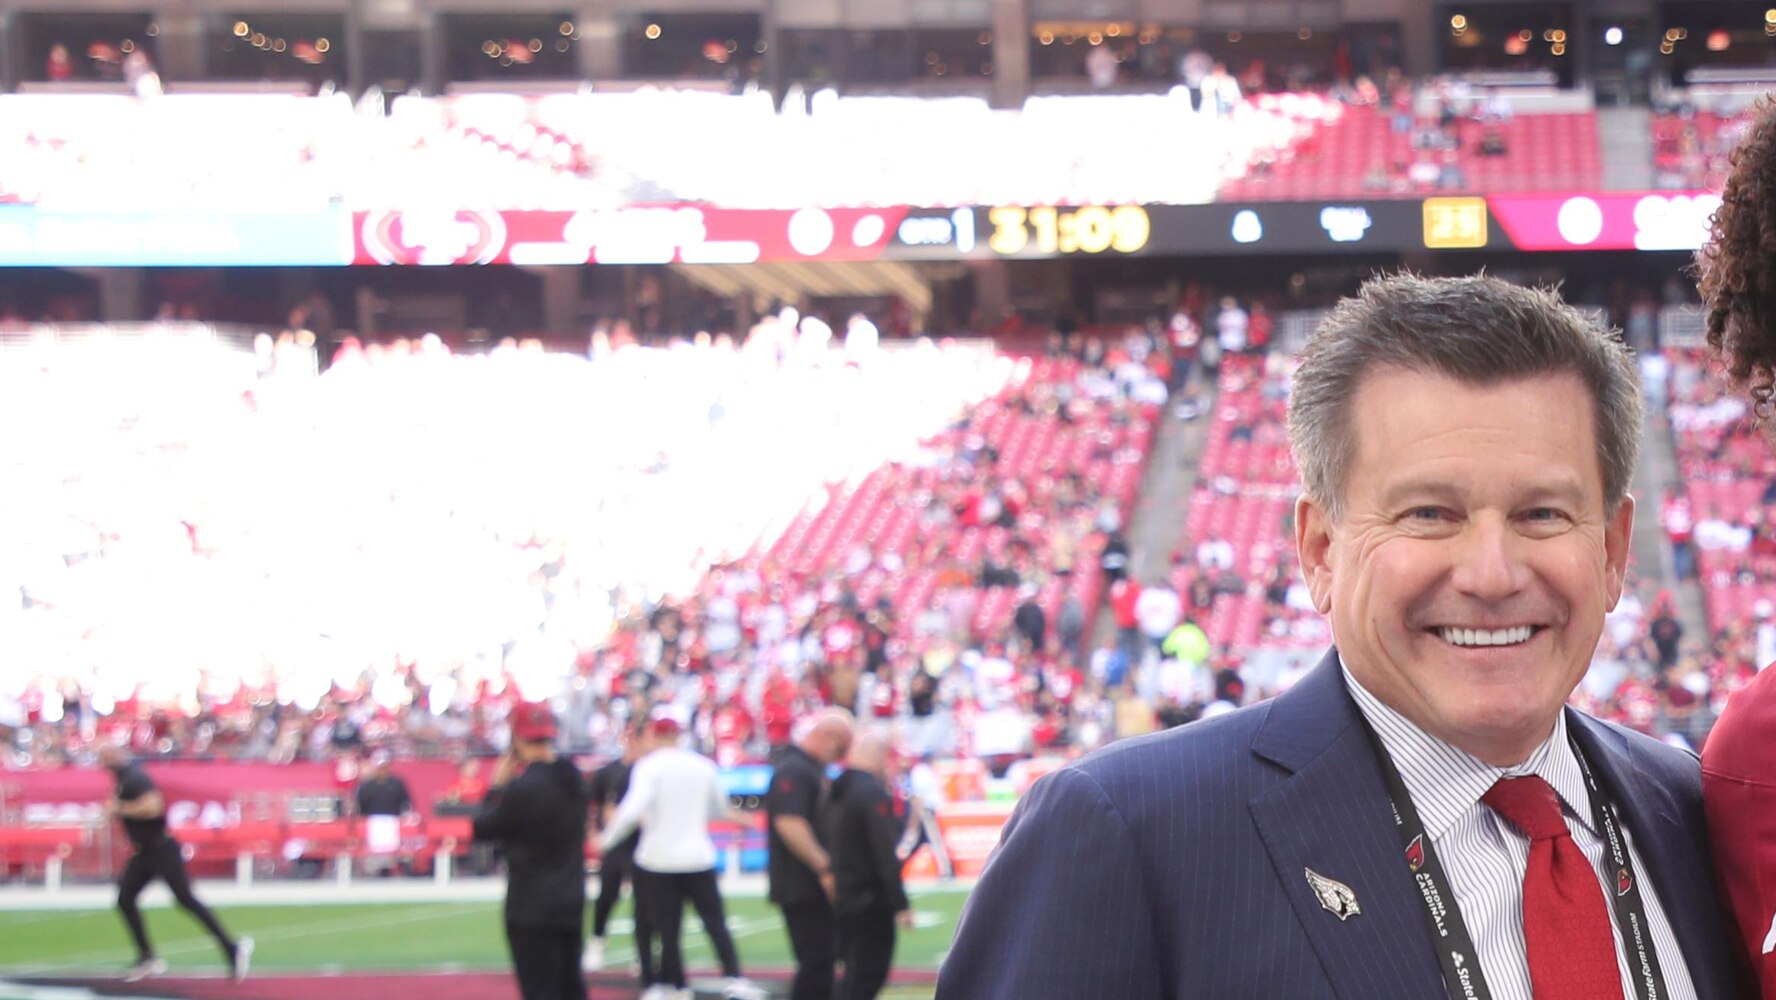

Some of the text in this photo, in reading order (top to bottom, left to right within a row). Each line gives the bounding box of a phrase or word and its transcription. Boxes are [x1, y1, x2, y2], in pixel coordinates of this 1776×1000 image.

[989, 206, 1150, 254] 31:09
[1415, 873, 1448, 938] CARDINALS
[1422, 872, 1446, 916] ARIZONA
[1629, 913, 1645, 951] STADIUM
